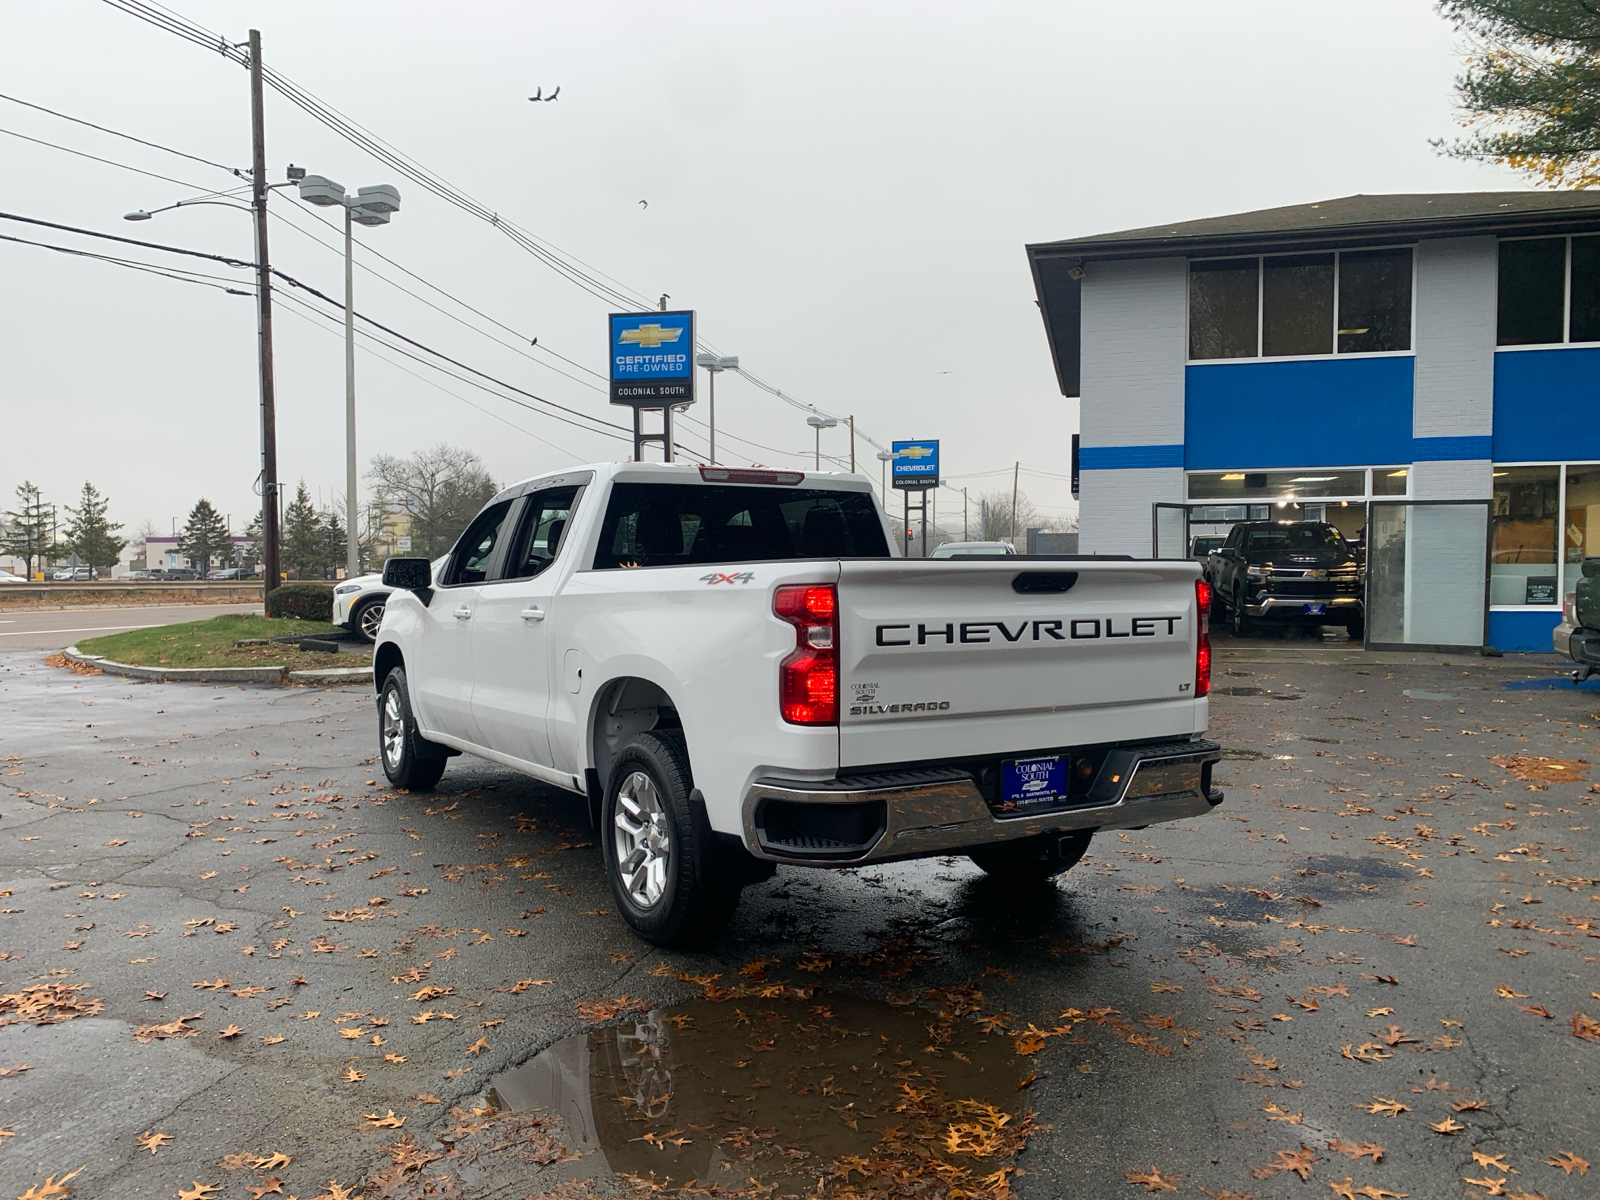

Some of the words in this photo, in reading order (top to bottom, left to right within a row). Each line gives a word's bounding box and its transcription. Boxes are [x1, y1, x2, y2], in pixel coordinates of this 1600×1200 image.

[616, 354, 686, 364] CERTIFIED
[619, 363, 683, 372] PRE-OWNED
[618, 388, 655, 396] COLONIAL
[876, 616, 1182, 646] CHEVROLET
[1178, 683, 1191, 692] LT
[849, 701, 950, 715] SILVERADO
[1015, 762, 1056, 774] COLONIAL
[1021, 771, 1049, 781] SOUTH
